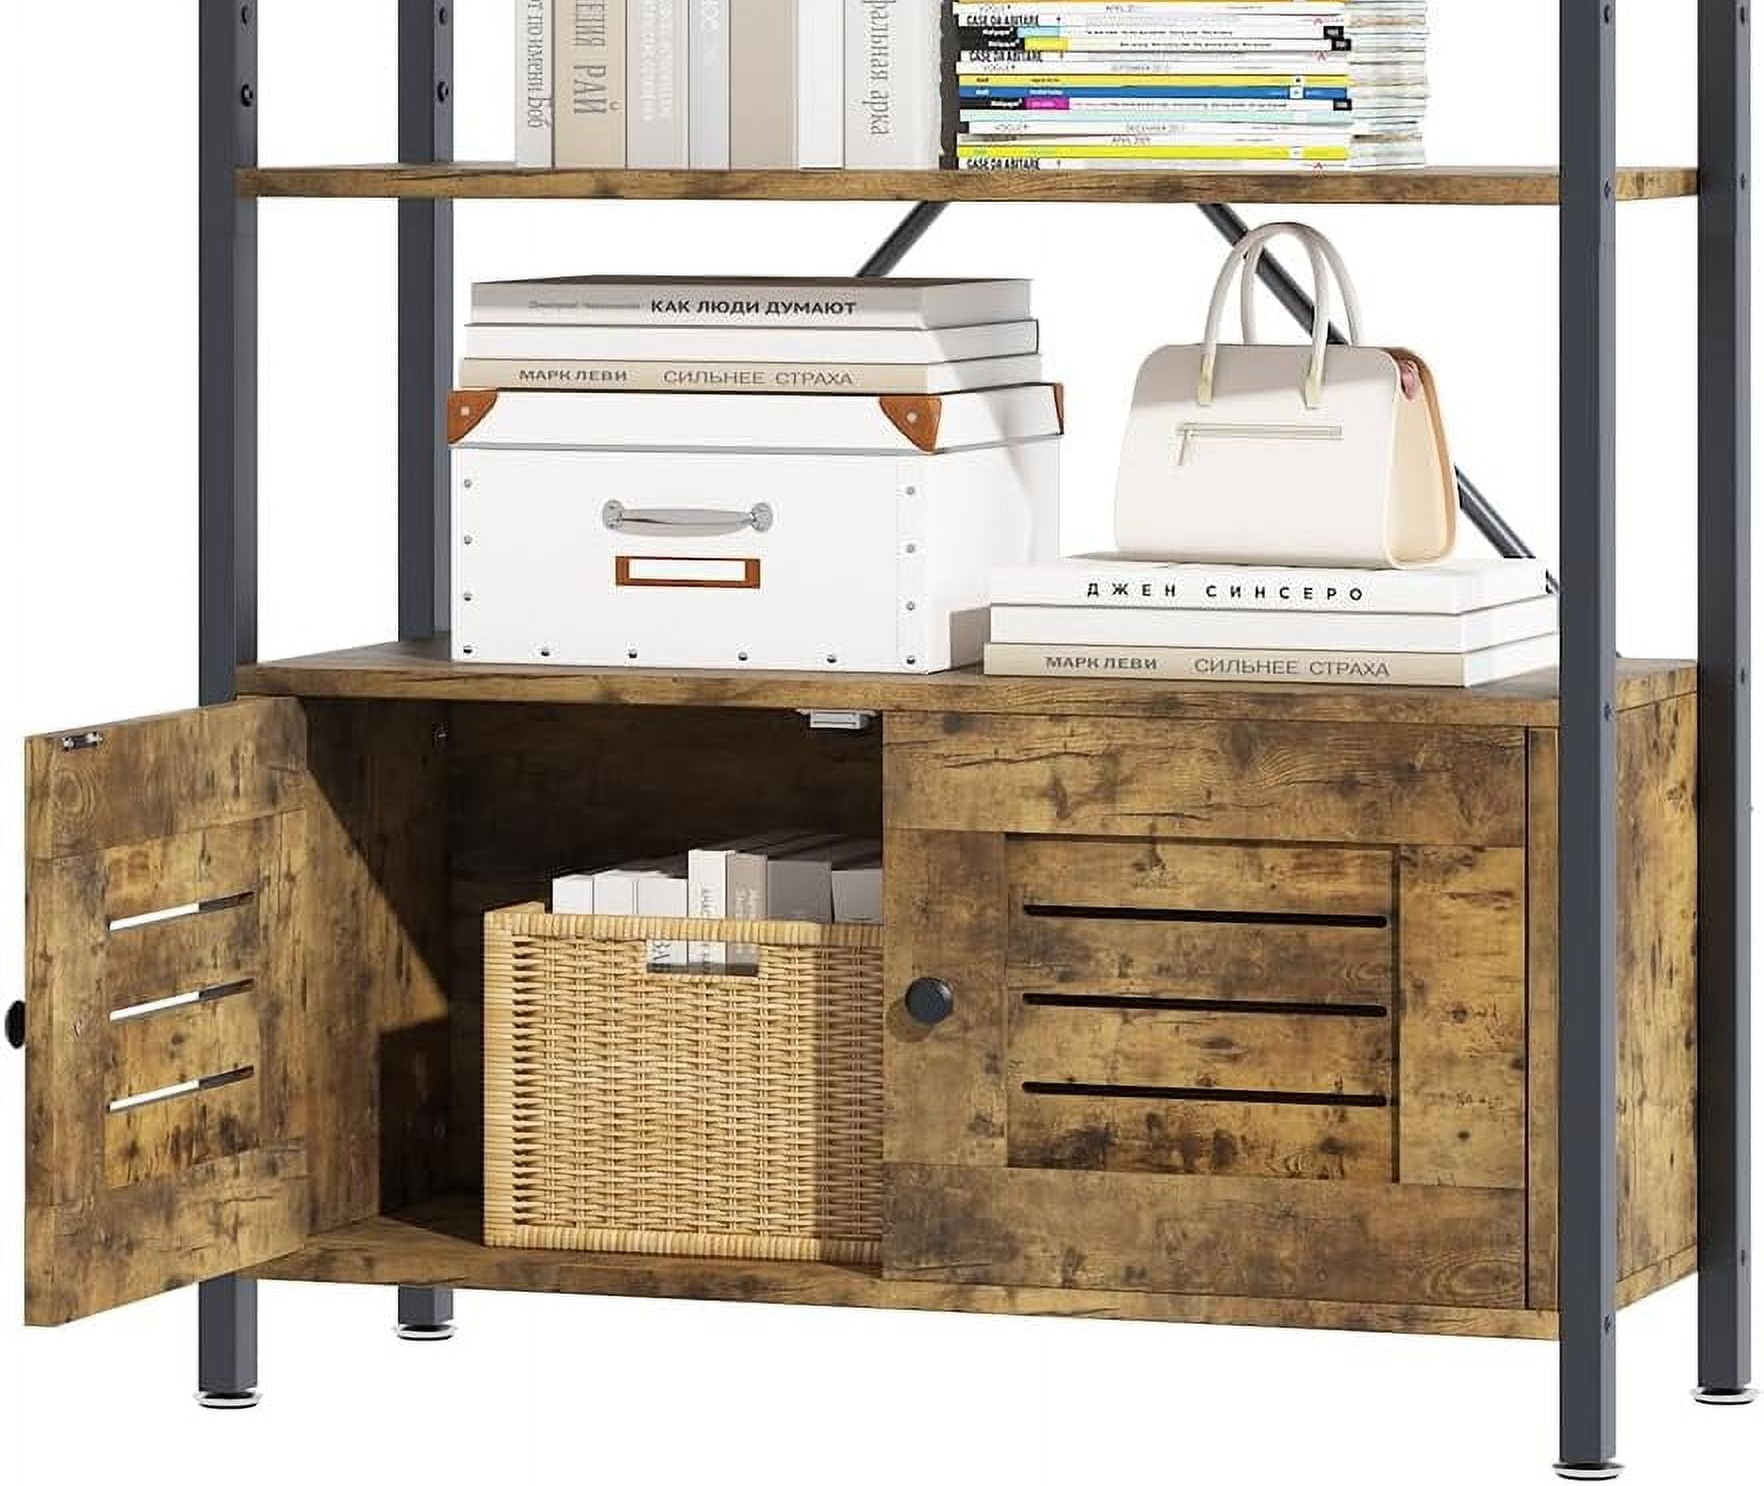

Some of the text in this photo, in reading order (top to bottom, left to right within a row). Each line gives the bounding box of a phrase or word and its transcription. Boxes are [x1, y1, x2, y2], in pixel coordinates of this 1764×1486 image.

[528, 15, 543, 36] по
[528, 39, 543, 91] имени
[573, 65, 620, 114] РАЙ
[528, 96, 552, 129] Боб
[861, 89, 889, 135] арка
[651, 300, 691, 314] КАК
[696, 300, 760, 315] ЛЮДИ
[765, 301, 858, 316] ДУМАЮТ
[519, 369, 854, 386] МАРК ЛЕВИ СИЛЬНЕЕ СТРАХА
[1087, 582, 1364, 602] ДЖЕН СИНСЕРО
[1045, 655, 1391, 678] МАРК ЛЕВИ СИЛЬНЕЕ СТРАХА
